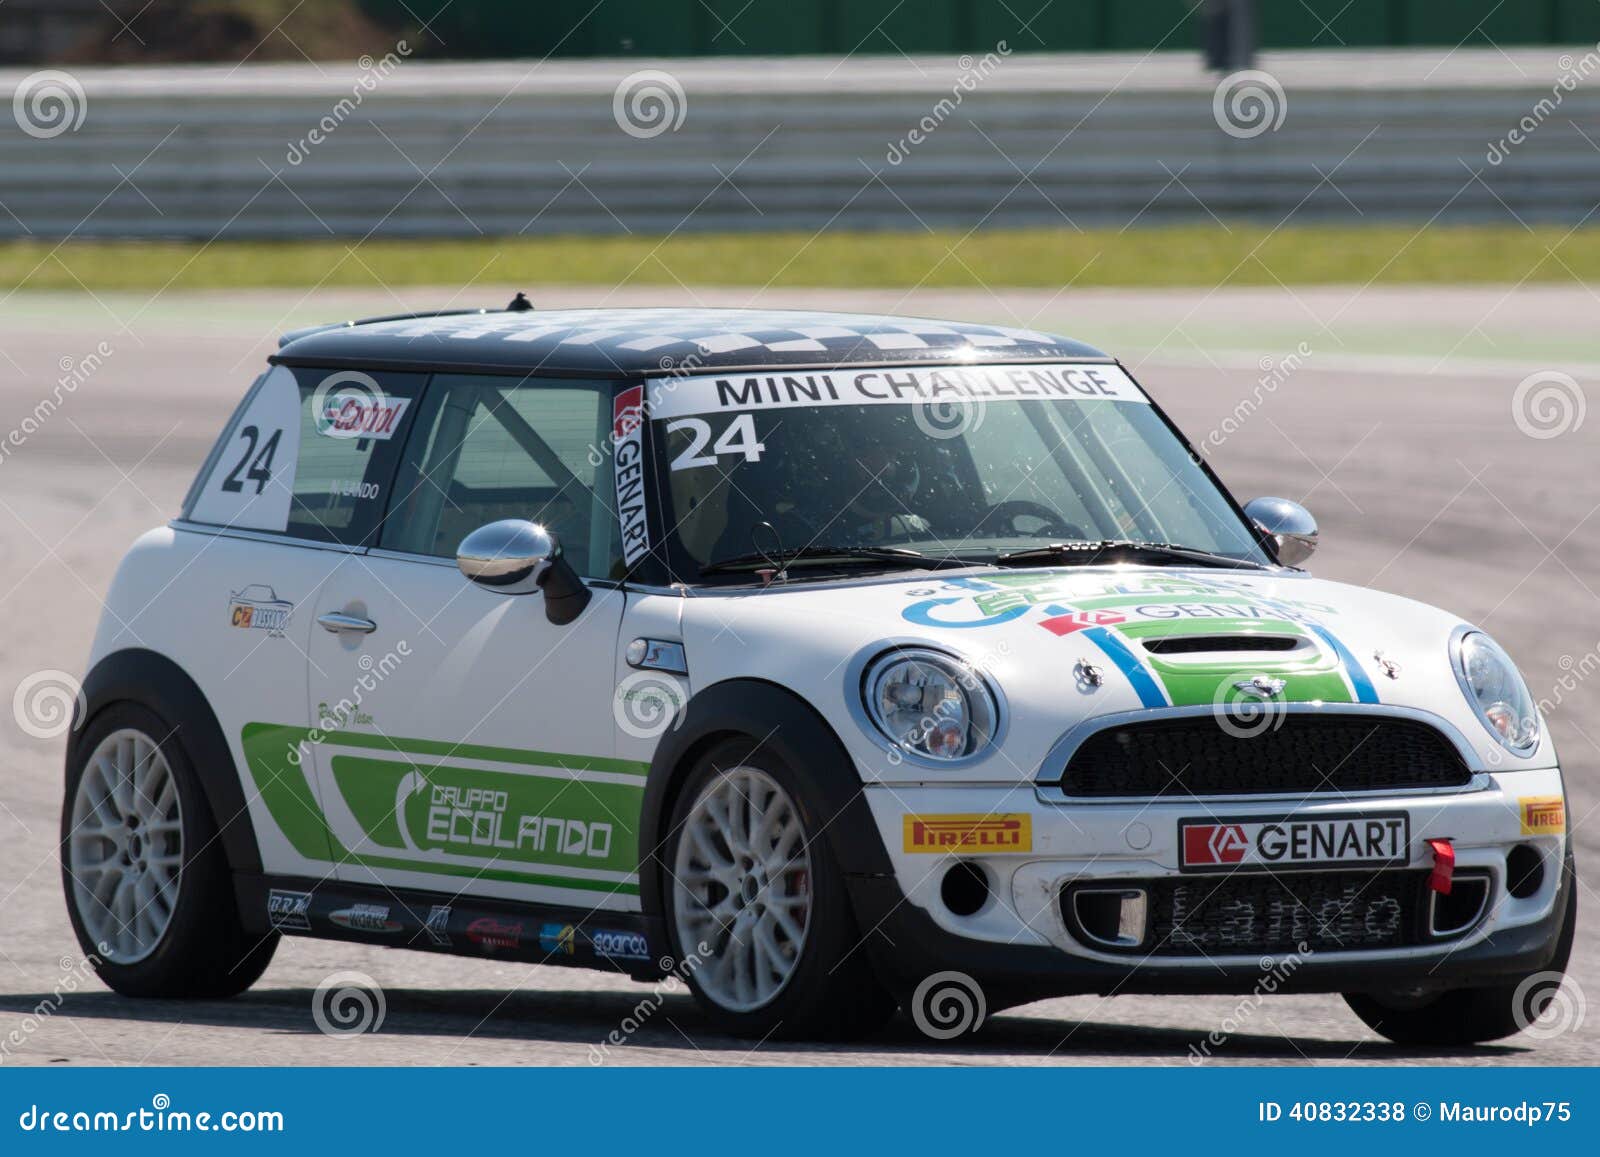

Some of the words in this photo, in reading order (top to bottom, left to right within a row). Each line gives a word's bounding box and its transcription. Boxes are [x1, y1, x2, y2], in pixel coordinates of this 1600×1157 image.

[716, 376, 840, 406] MINI
[854, 370, 1118, 400] CHALLENGE
[221, 425, 283, 496] 24
[667, 414, 765, 471] 24
[616, 440, 649, 558] GENART
[431, 785, 508, 812] GRUPPO
[427, 806, 612, 858] ECOLANDO
[913, 821, 1021, 846] PIRELLI
[1257, 821, 1402, 861] GENART
[593, 932, 648, 956] sparco
